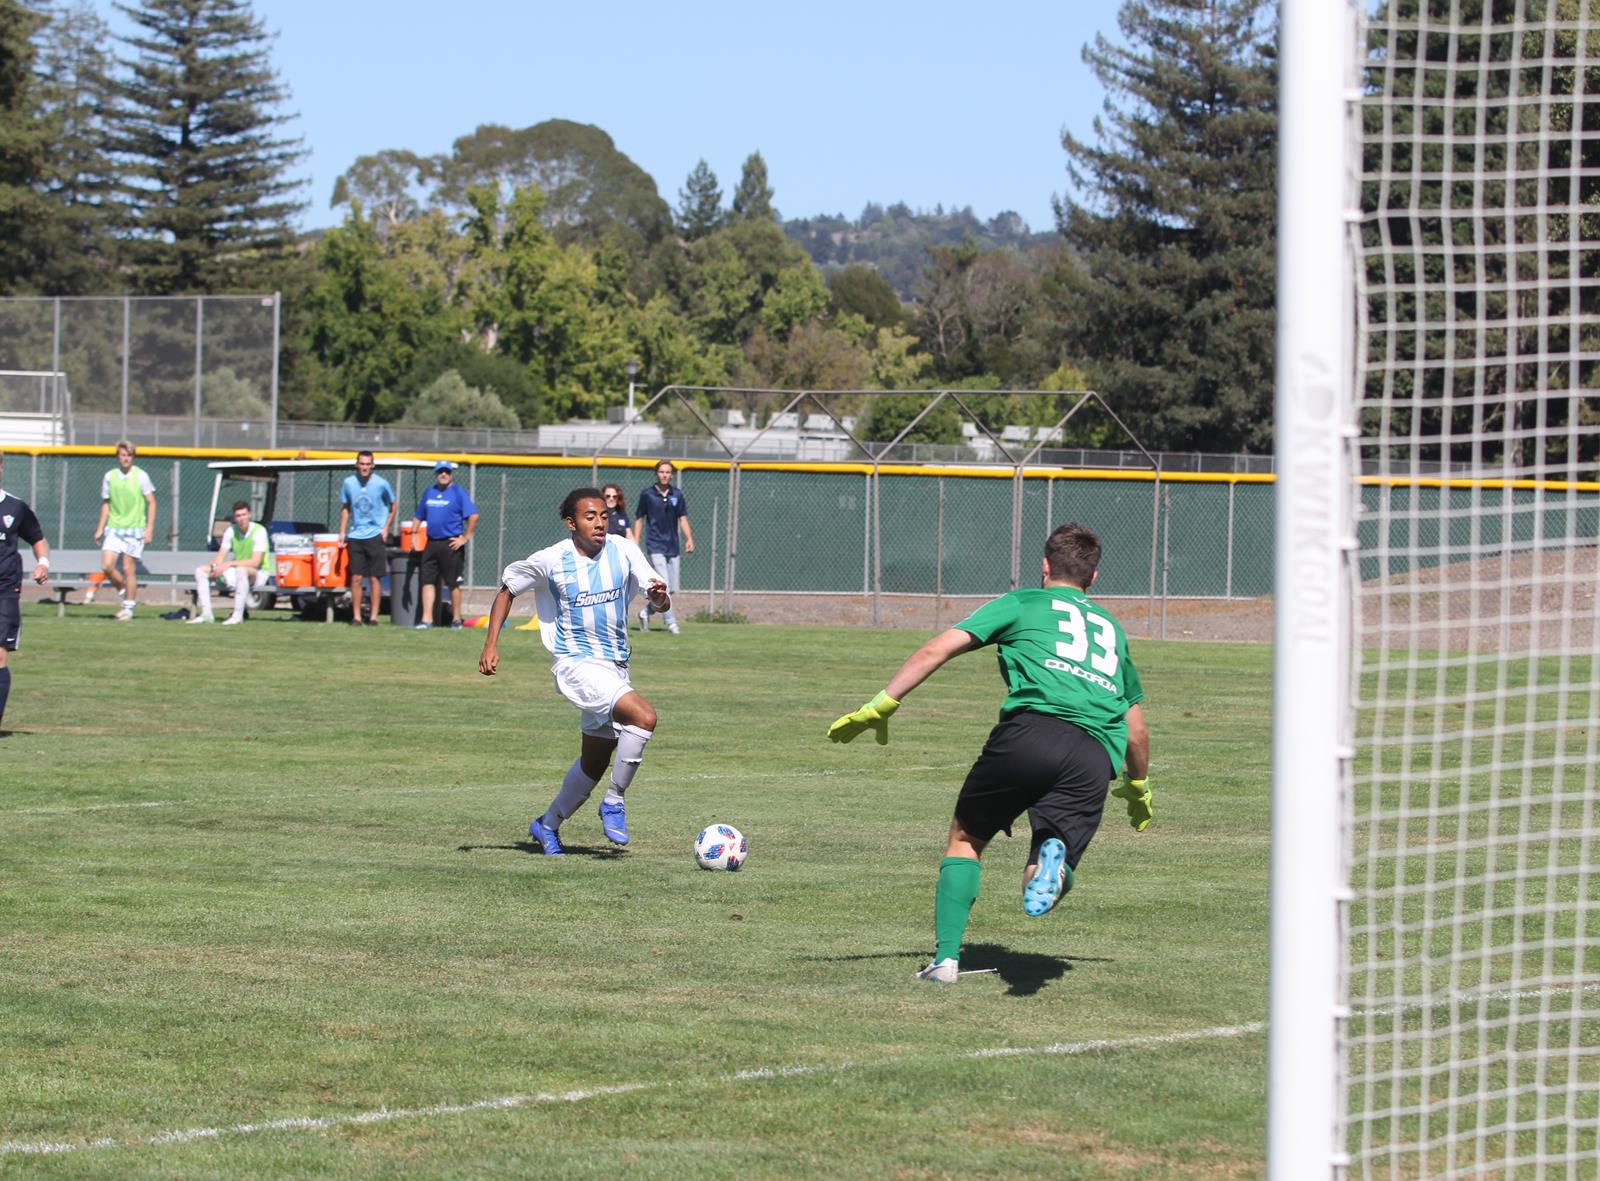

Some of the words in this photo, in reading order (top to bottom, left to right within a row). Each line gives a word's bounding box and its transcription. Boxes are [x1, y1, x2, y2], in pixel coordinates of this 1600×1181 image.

[574, 588, 621, 607] SONOMA
[1051, 599, 1118, 676] 33
[1045, 659, 1117, 694] CONCORDIA
